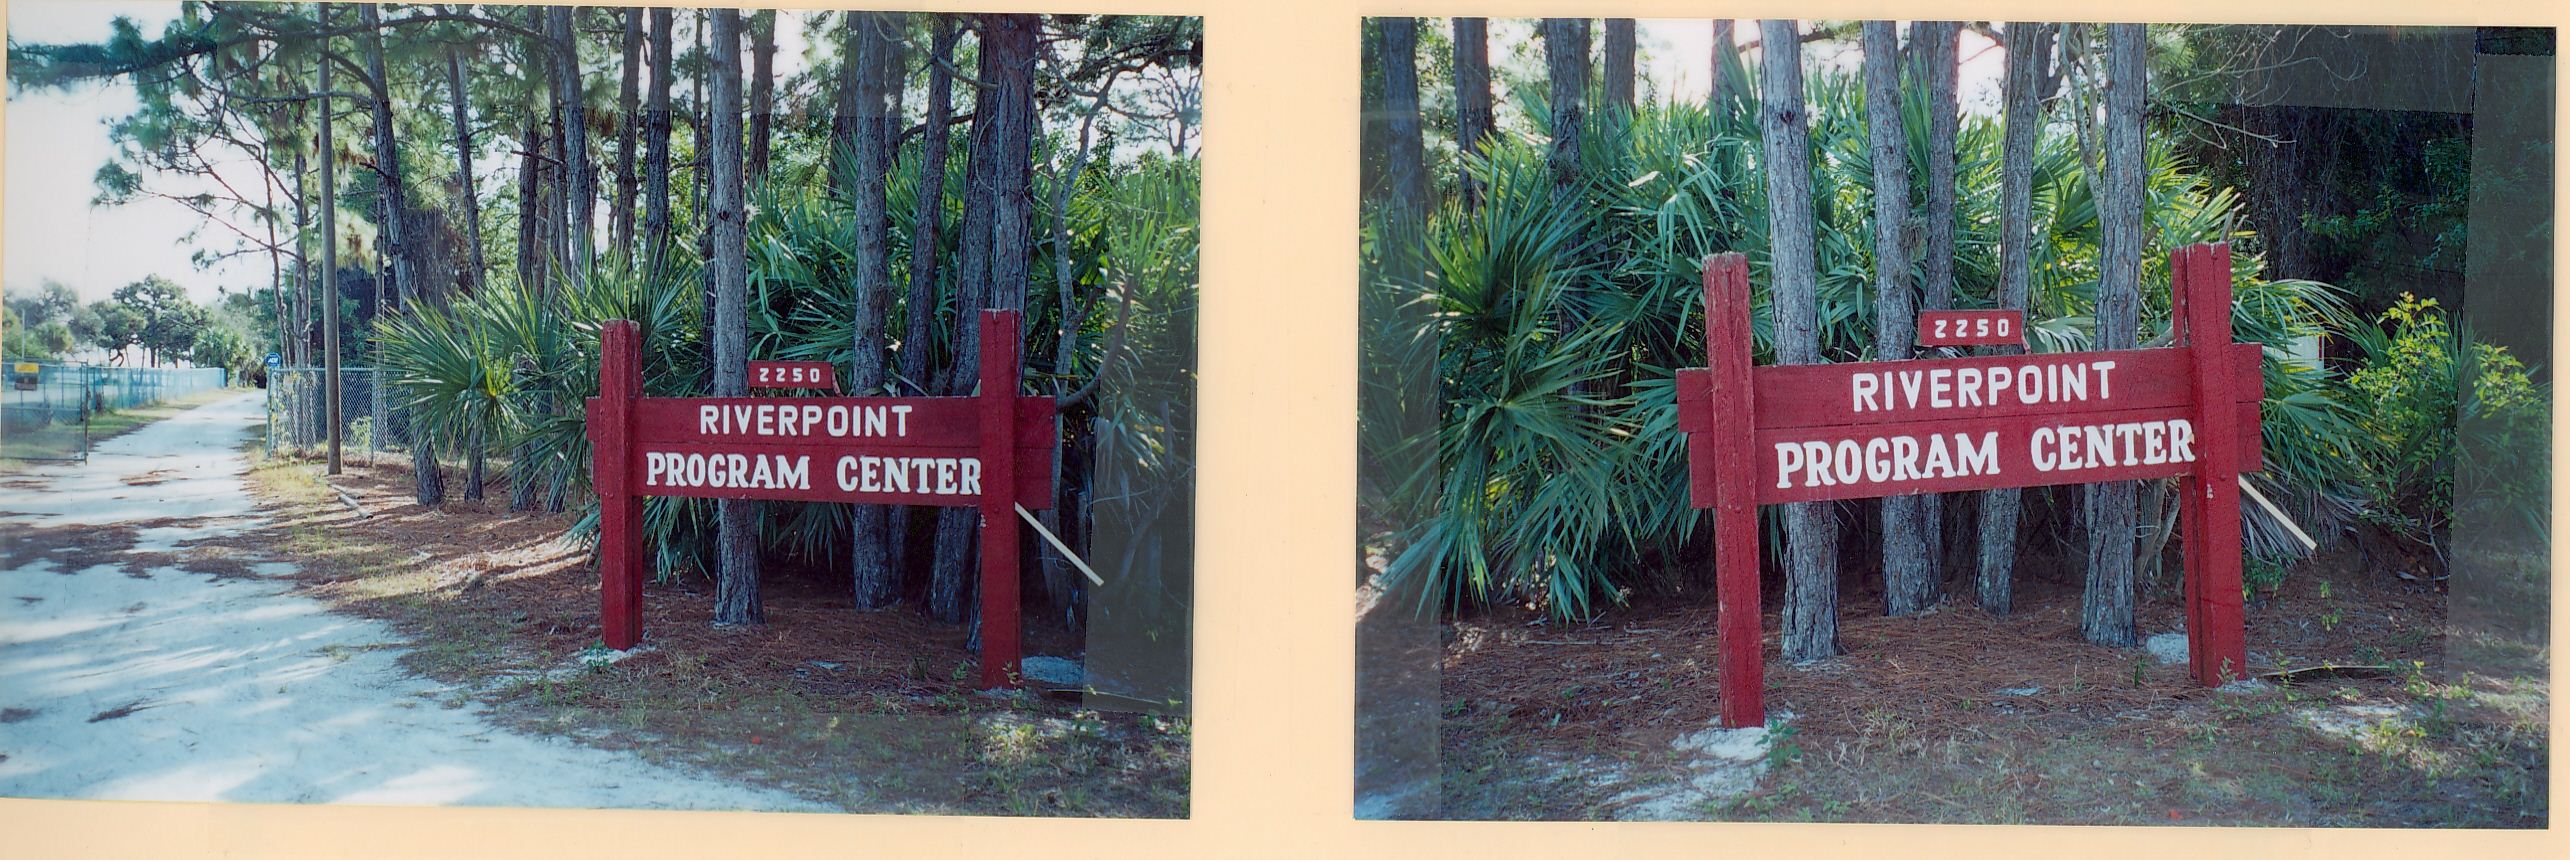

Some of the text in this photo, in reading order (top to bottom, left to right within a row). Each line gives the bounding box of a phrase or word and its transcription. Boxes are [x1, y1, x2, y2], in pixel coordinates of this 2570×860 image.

[1934, 318, 2010, 339] 2250
[759, 367, 820, 383] 2250
[1853, 361, 2116, 413] RIVERPOINT
[701, 405, 913, 437] RIVERPOINT
[1775, 419, 2196, 489] PROGRAM CENTER
[646, 452, 982, 495] PROGRAM CENTER
